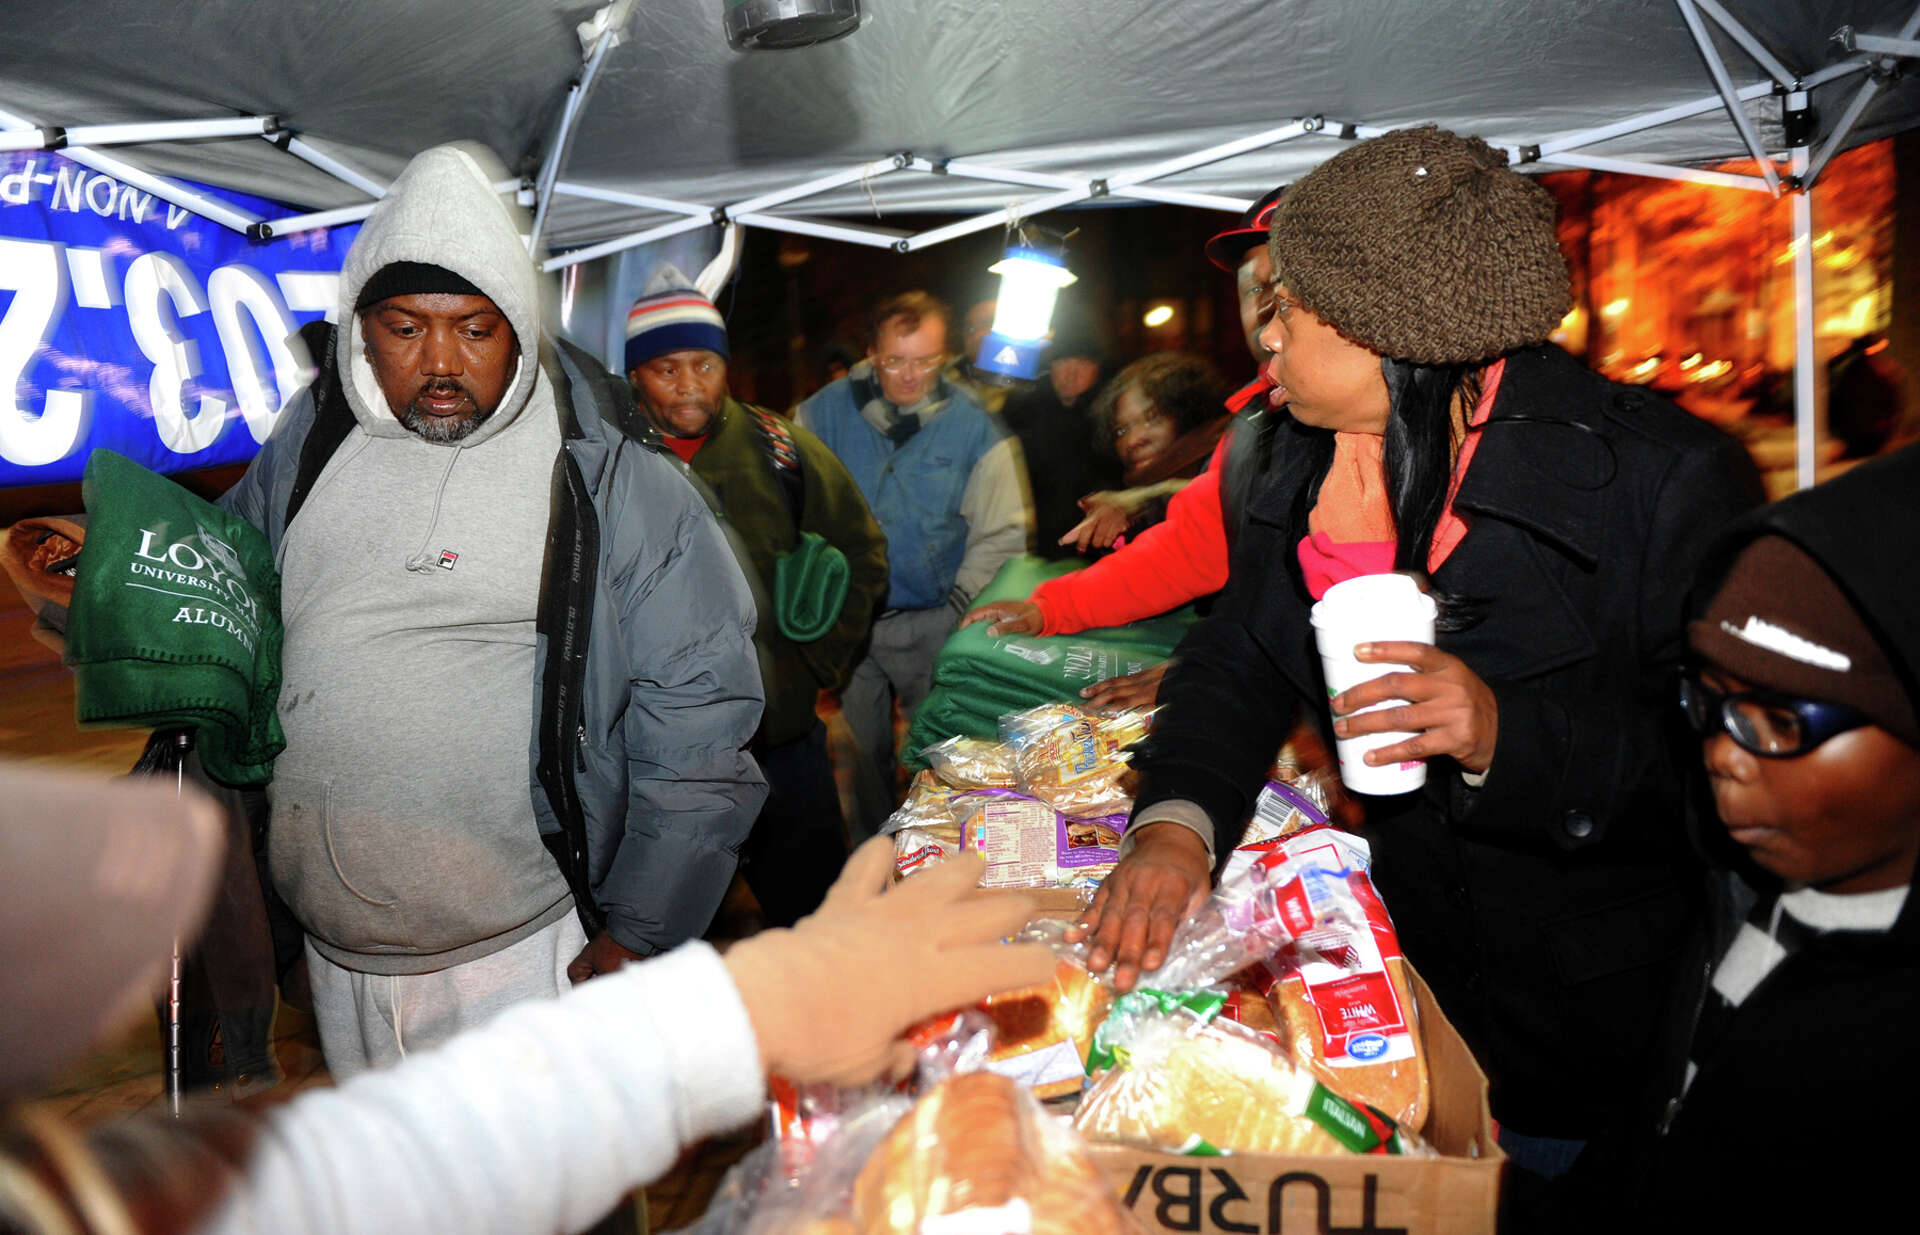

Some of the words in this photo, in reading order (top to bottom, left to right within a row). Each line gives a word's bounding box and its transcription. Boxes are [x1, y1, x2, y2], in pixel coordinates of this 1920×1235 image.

[0, 238, 340, 466] 03.2
[130, 562, 230, 602] UNIVERSITY
[134, 528, 258, 621] LOYOL
[1339, 1003, 1376, 1021] WHITE
